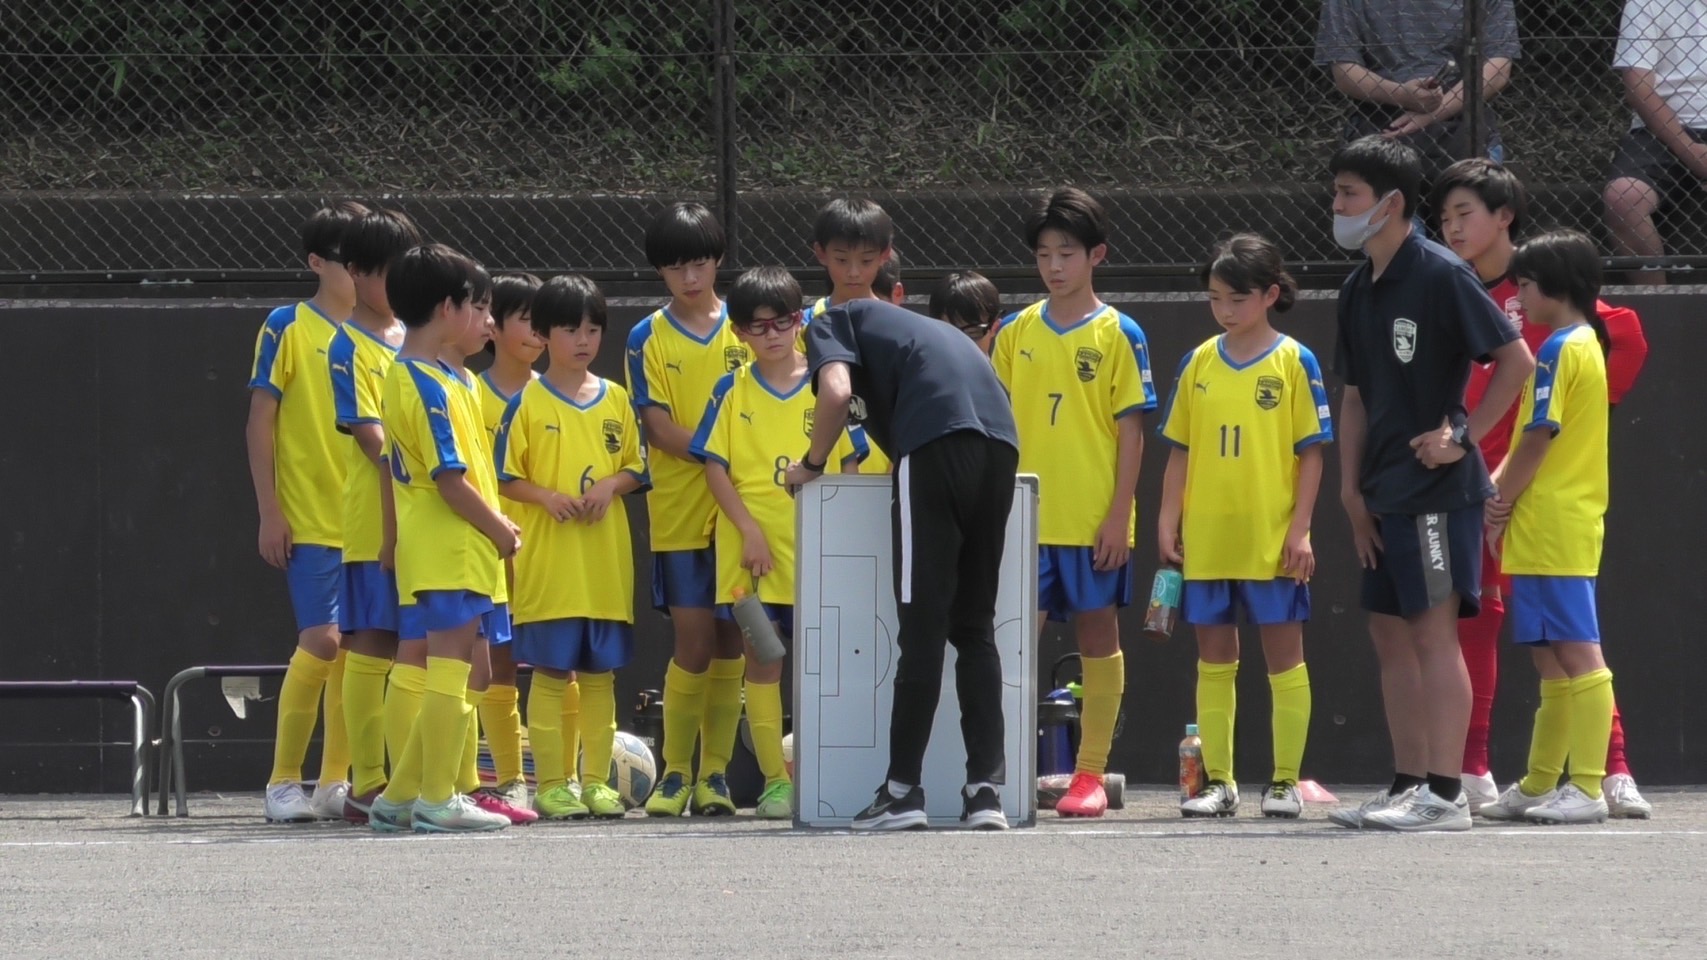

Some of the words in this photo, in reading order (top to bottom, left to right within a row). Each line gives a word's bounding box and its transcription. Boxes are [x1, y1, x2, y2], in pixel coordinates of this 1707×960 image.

[1048, 393, 1062, 426] 7
[1219, 424, 1241, 458] 11
[773, 455, 790, 487] 8
[1427, 528, 1445, 571] JUNKY
